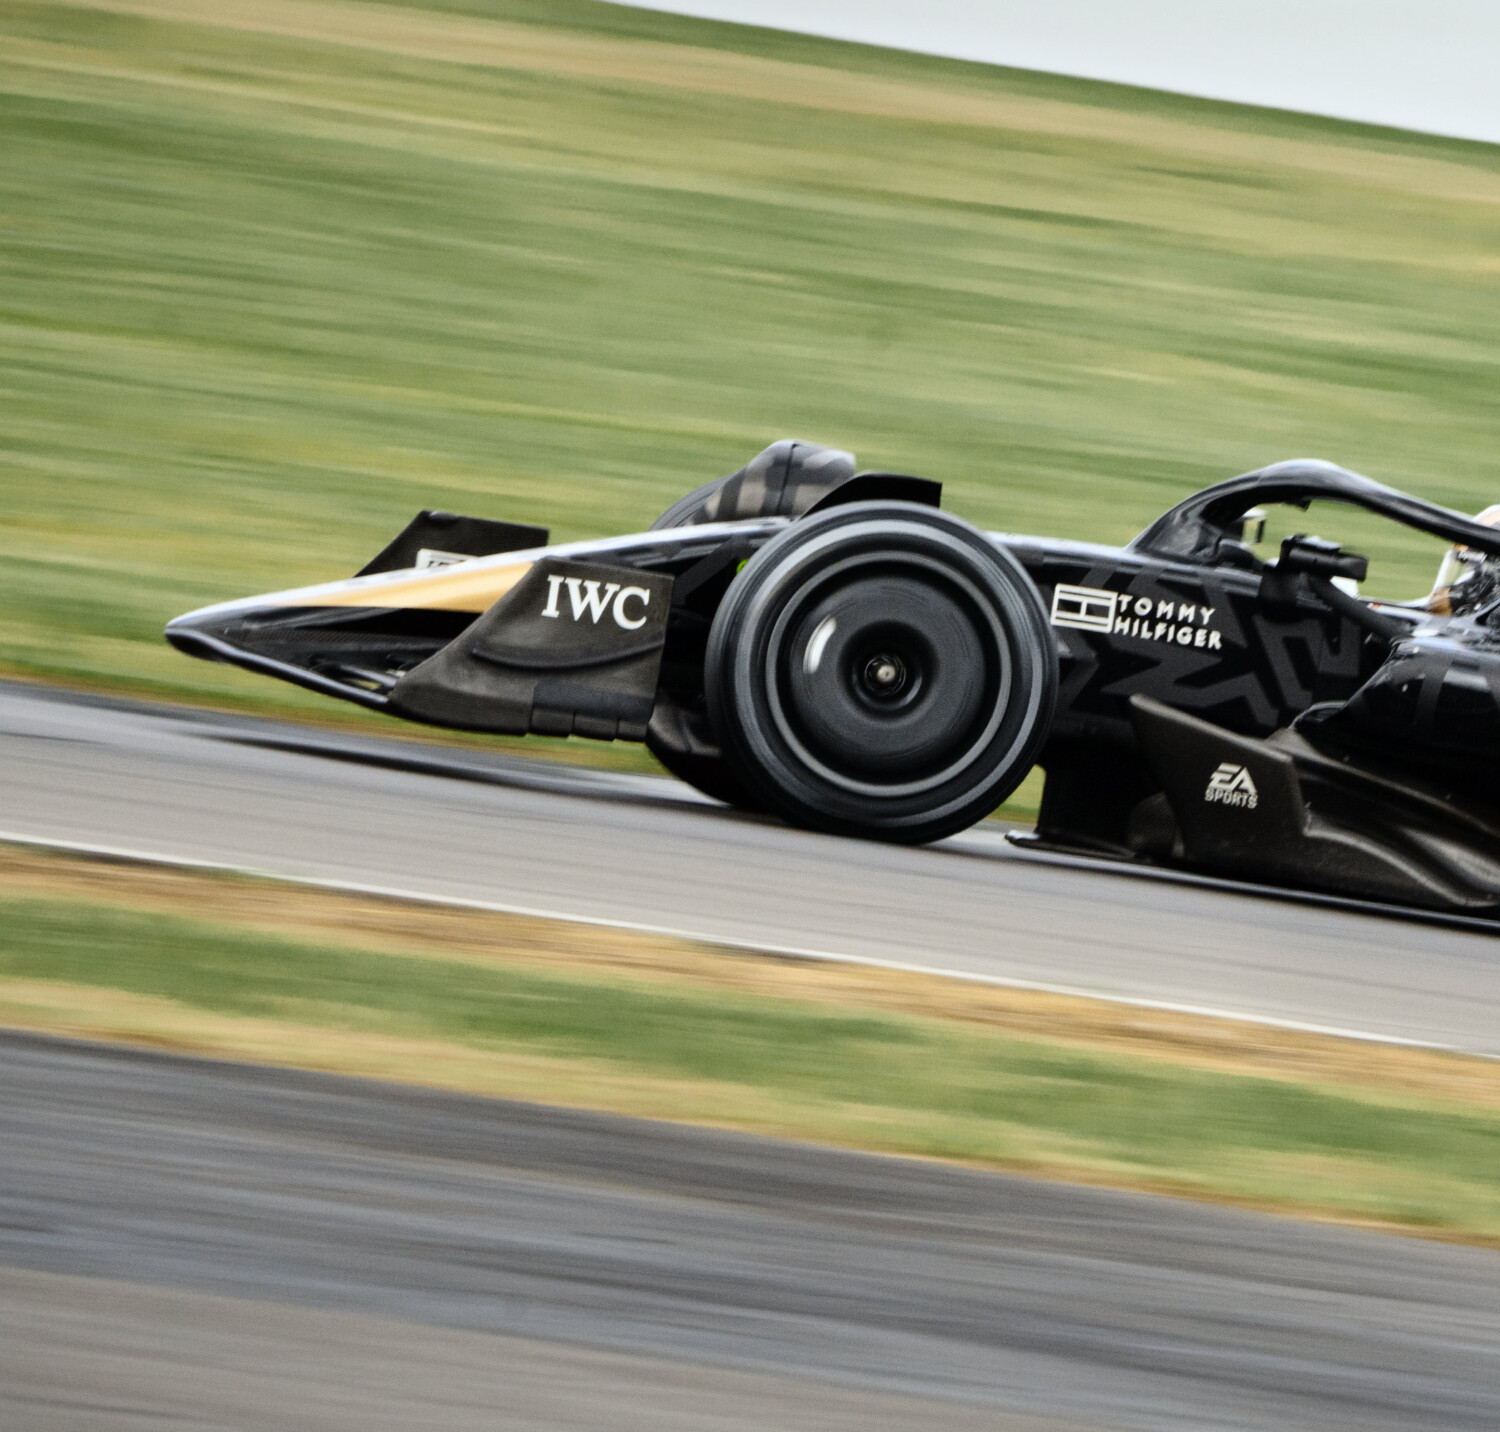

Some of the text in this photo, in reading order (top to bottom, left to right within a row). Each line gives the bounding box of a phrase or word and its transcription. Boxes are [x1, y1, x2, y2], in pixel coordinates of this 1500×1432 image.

[541, 574, 650, 630] IWC
[1118, 594, 1216, 625] TOMMY
[1114, 616, 1222, 650] HILFIGER
[1209, 762, 1257, 794] EA
[1204, 786, 1258, 809] SPORTS
